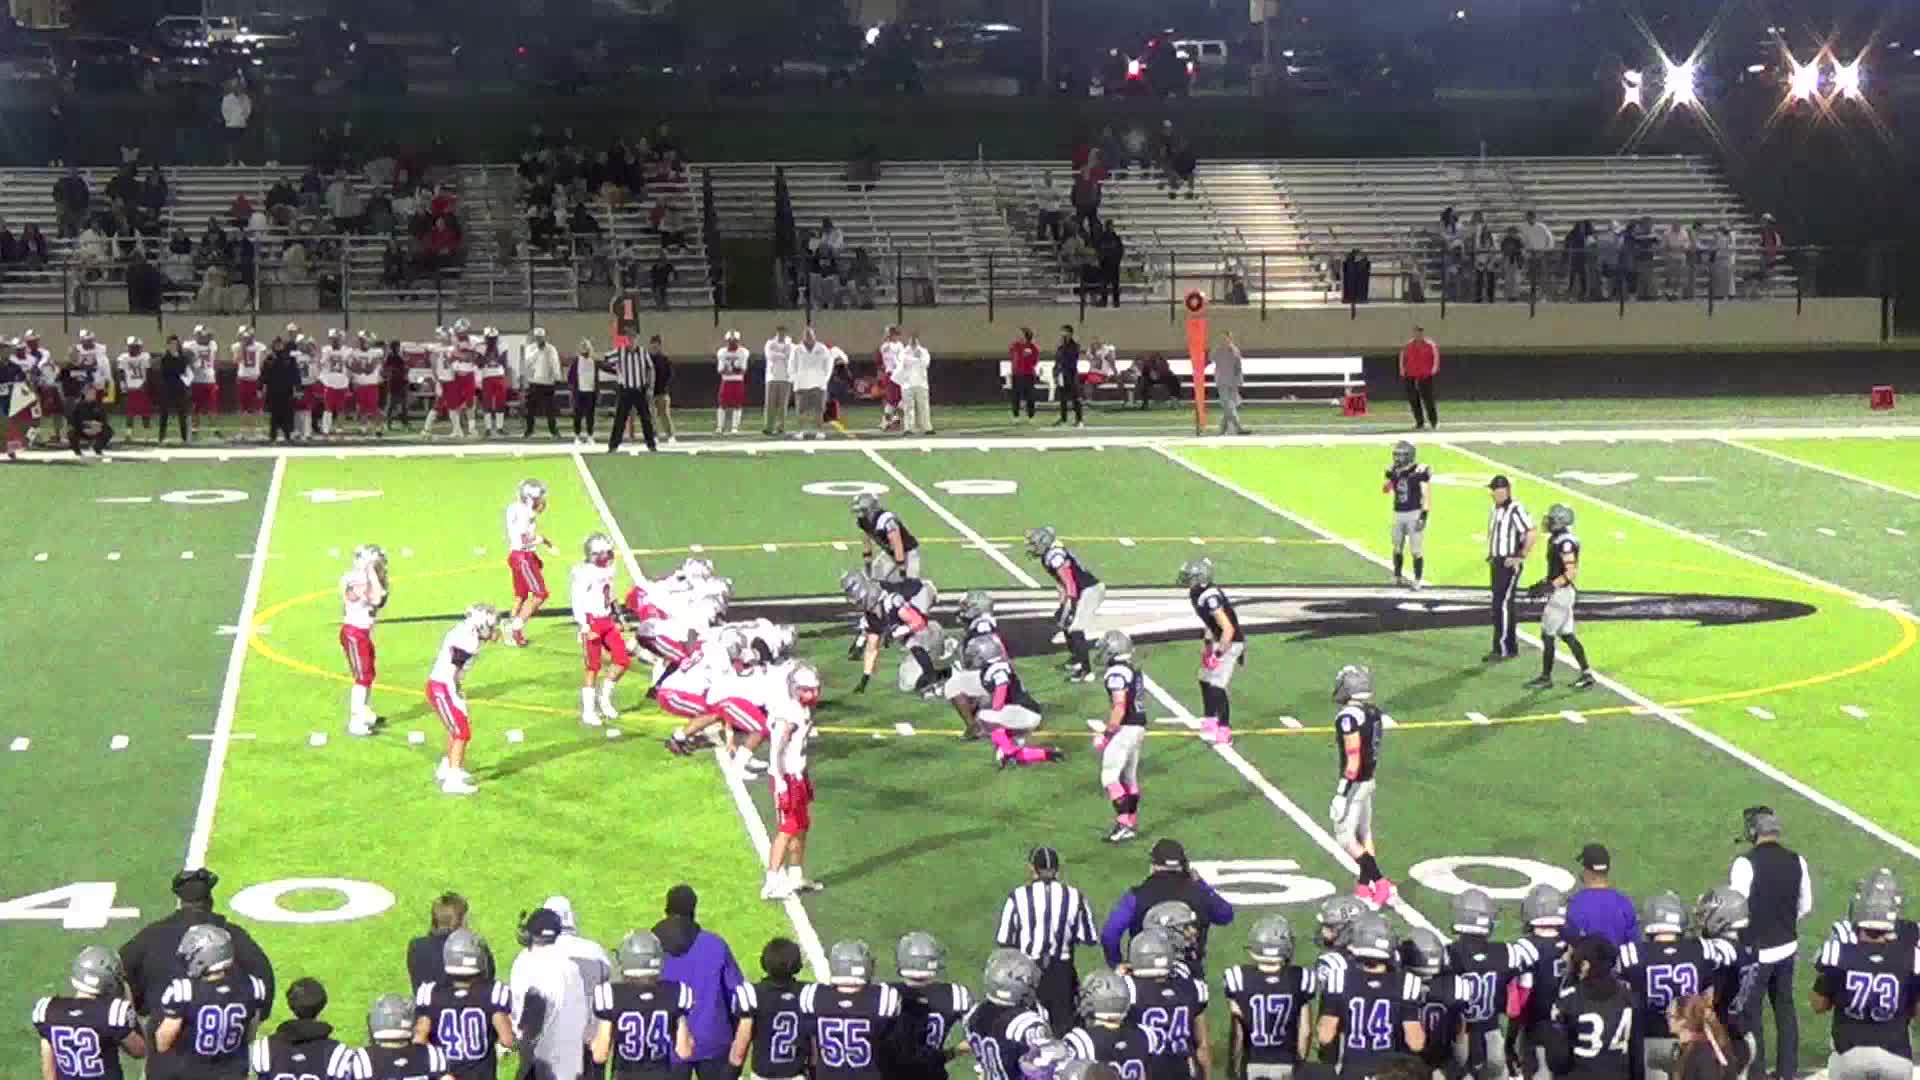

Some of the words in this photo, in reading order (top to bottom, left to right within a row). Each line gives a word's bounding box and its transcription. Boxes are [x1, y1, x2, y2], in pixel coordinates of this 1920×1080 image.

[1248, 993, 1293, 1047] 17
[1845, 970, 1900, 1022] 73
[196, 1002, 247, 1055] 86
[437, 1007, 489, 1061] 40
[617, 1010, 671, 1062] 34
[769, 1011, 799, 1063] 2
[819, 1017, 872, 1068] 55
[1347, 997, 1393, 1050] 14
[1573, 1007, 1633, 1058] 34
[50, 1025, 105, 1078] 52
